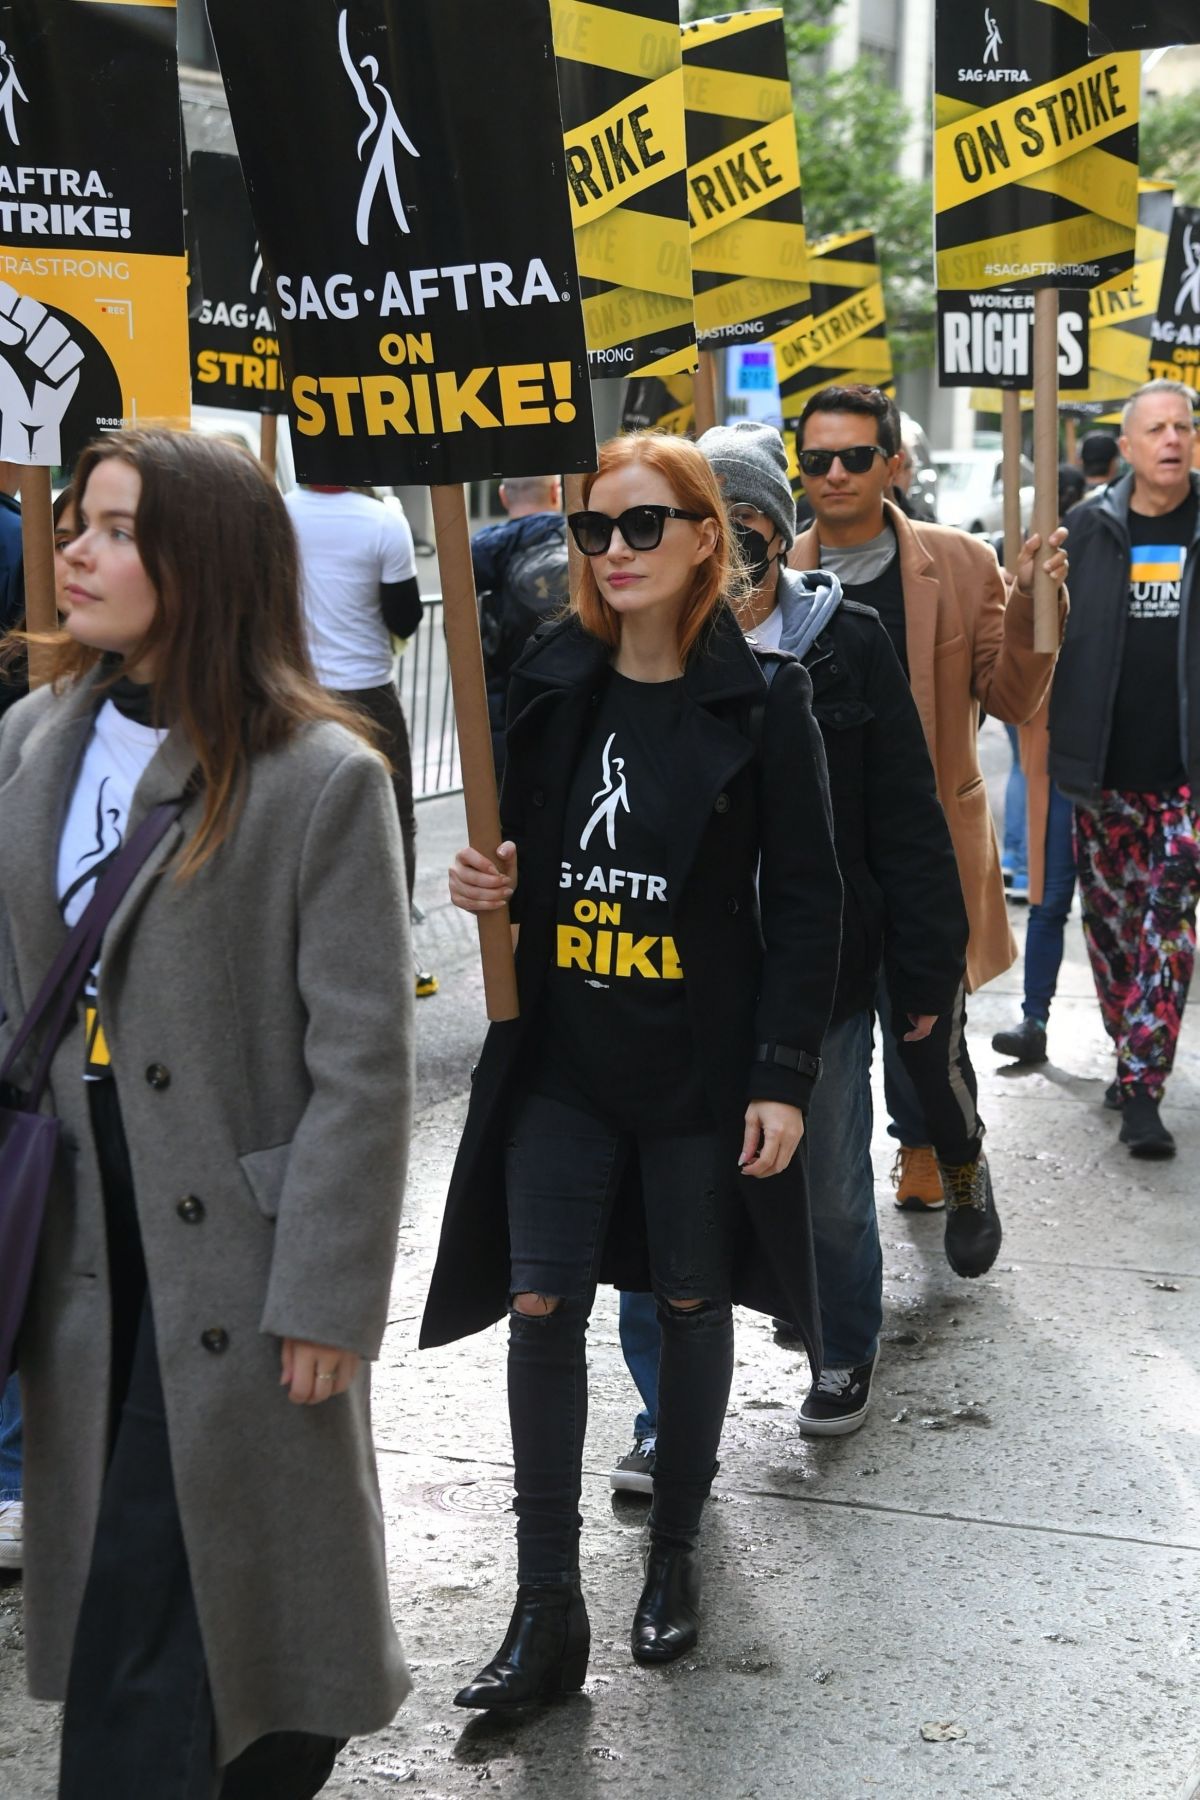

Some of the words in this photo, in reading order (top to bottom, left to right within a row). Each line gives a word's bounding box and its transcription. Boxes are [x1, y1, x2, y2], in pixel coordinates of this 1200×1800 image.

[954, 119, 1011, 183] ON
[1014, 65, 1127, 158] STRIKE
[690, 141, 783, 228] RIKE
[198, 299, 276, 332] SAG·A
[809, 297, 876, 352] STRIKE
[252, 337, 280, 356] ON
[379, 332, 434, 365] ON
[943, 311, 1084, 376] RIGHS
[197, 350, 285, 391] STRI
[292, 361, 576, 437] STRIKE!
[574, 899, 621, 926] ON
